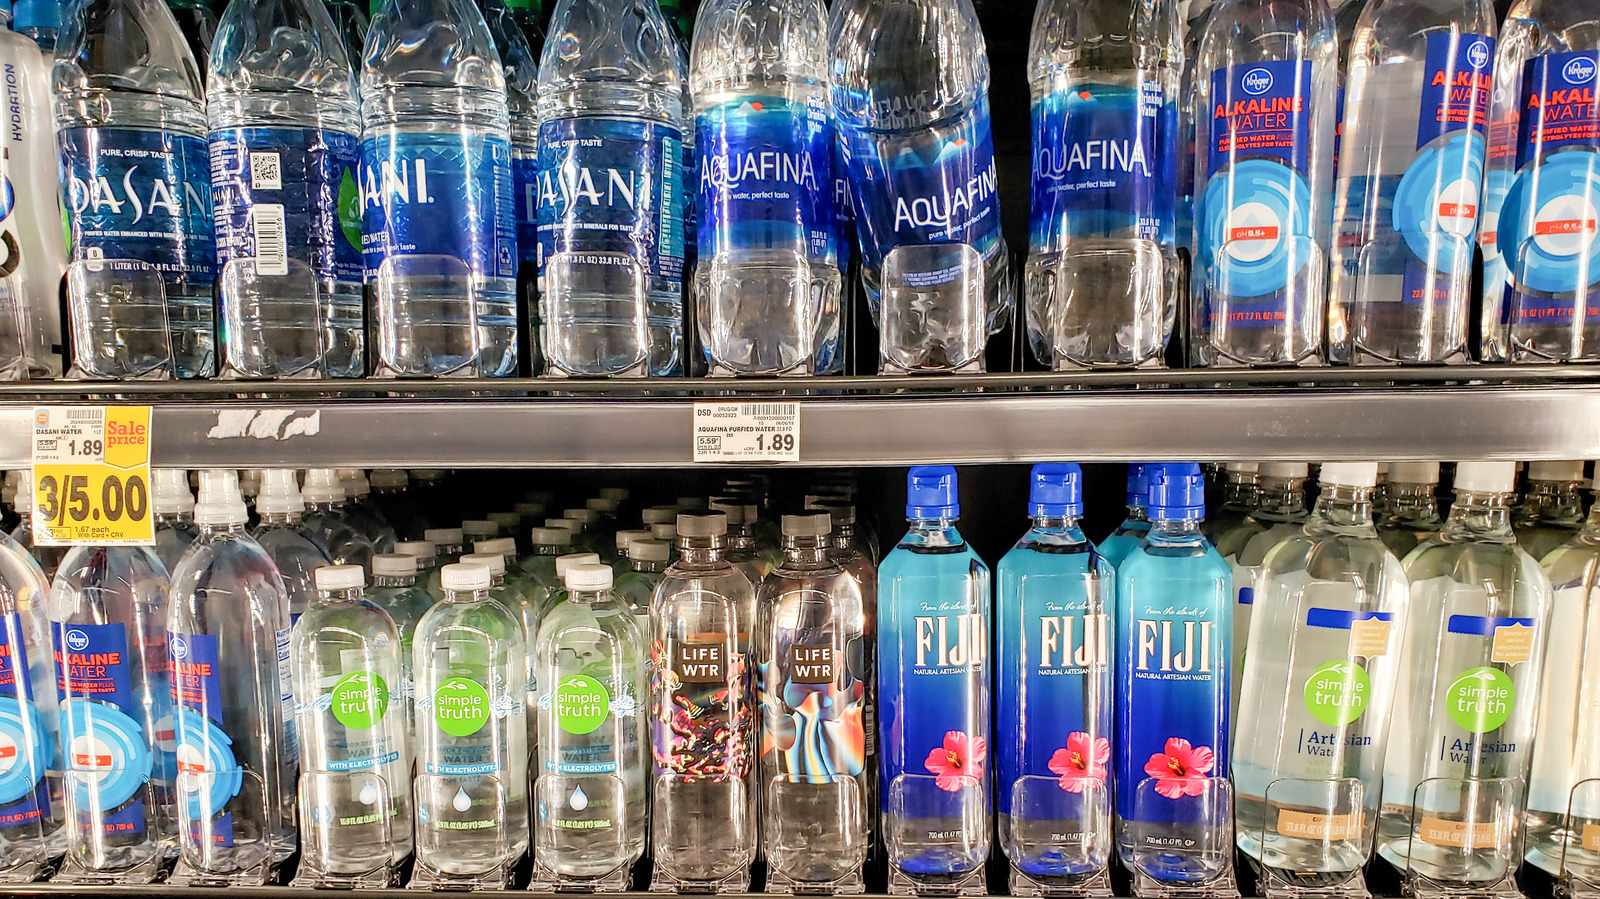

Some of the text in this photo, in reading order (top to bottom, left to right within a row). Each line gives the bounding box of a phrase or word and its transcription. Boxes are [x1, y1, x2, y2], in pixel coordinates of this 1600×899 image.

[1568, 61, 1594, 79] Kroger
[1246, 73, 1270, 90] Kroger
[4, 63, 23, 141] HYDRATION
[807, 96, 826, 108] Purified
[1214, 97, 1304, 119] ALKALINE
[807, 108, 827, 124] Drinking
[1437, 108, 1468, 116] PRIFIED
[1227, 113, 1287, 131] WATER
[1531, 125, 1598, 136] PRIFIED WATER
[581, 139, 603, 147] TASTE
[1218, 136, 1248, 145] PURIED
[1530, 134, 1582, 143] EECTROLYTES
[1218, 142, 1261, 152] ELEROLYTES
[100, 148, 174, 160] PURE, CRISP TASTE
[536, 156, 651, 216] ASANI
[1076, 180, 1099, 191] perfect
[1099, 180, 1116, 188] taste
[733, 191, 790, 200] water, perfect taste
[929, 231, 944, 240] pure
[114, 262, 132, 270] LITER
[162, 263, 171, 271] FL
[599, 256, 612, 264] 33.8
[613, 257, 621, 265] FL
[622, 257, 630, 266] OZ
[107, 420, 146, 436] Sale
[68, 439, 103, 456] 1.89
[107, 435, 146, 448] price
[756, 433, 795, 452] 1.89
[38, 474, 147, 527] 3/5.00
[919, 601, 949, 611] From the
[1045, 601, 1063, 611] From
[1064, 601, 1075, 611] the
[1143, 605, 1209, 618] From the islands of
[914, 613, 982, 667] FIJI
[1038, 613, 1108, 667] FIJI
[1135, 619, 1213, 673] FIJI
[682, 648, 719, 660] LIFE
[795, 648, 831, 661] LIFE
[682, 664, 719, 677] WTR
[795, 664, 832, 677] WTR
[939, 667, 965, 675] ARTESIAN
[1135, 672, 1162, 680] NATURAL
[1316, 678, 1364, 693] simple
[340, 686, 382, 701] simple
[558, 692, 601, 706] simple
[1315, 690, 1362, 707] truth
[1458, 685, 1508, 700] simple
[340, 698, 383, 714] truth
[438, 695, 482, 708] simple
[1457, 697, 1506, 714] truth
[438, 705, 483, 719] truth
[558, 704, 601, 717] truth
[1307, 731, 1371, 746] Artsian
[1307, 745, 1337, 757] Wat
[1450, 738, 1516, 753] Aresian
[329, 752, 398, 769] WITH ELECTROLYTES
[444, 754, 483, 764] WATER
[1450, 752, 1487, 764] War
[428, 763, 498, 773] WTH ELECTROLYTES
[547, 763, 616, 772] WIH ELECTROLYTES
[1285, 822, 1316, 834] 33.8 FL OZ
[928, 831, 937, 839] 700
[1051, 833, 1061, 841] 700
[1145, 836, 1155, 844] 700
[1163, 837, 1174, 845] (1.47
[1428, 830, 1459, 842] 33.8 FL OZ
